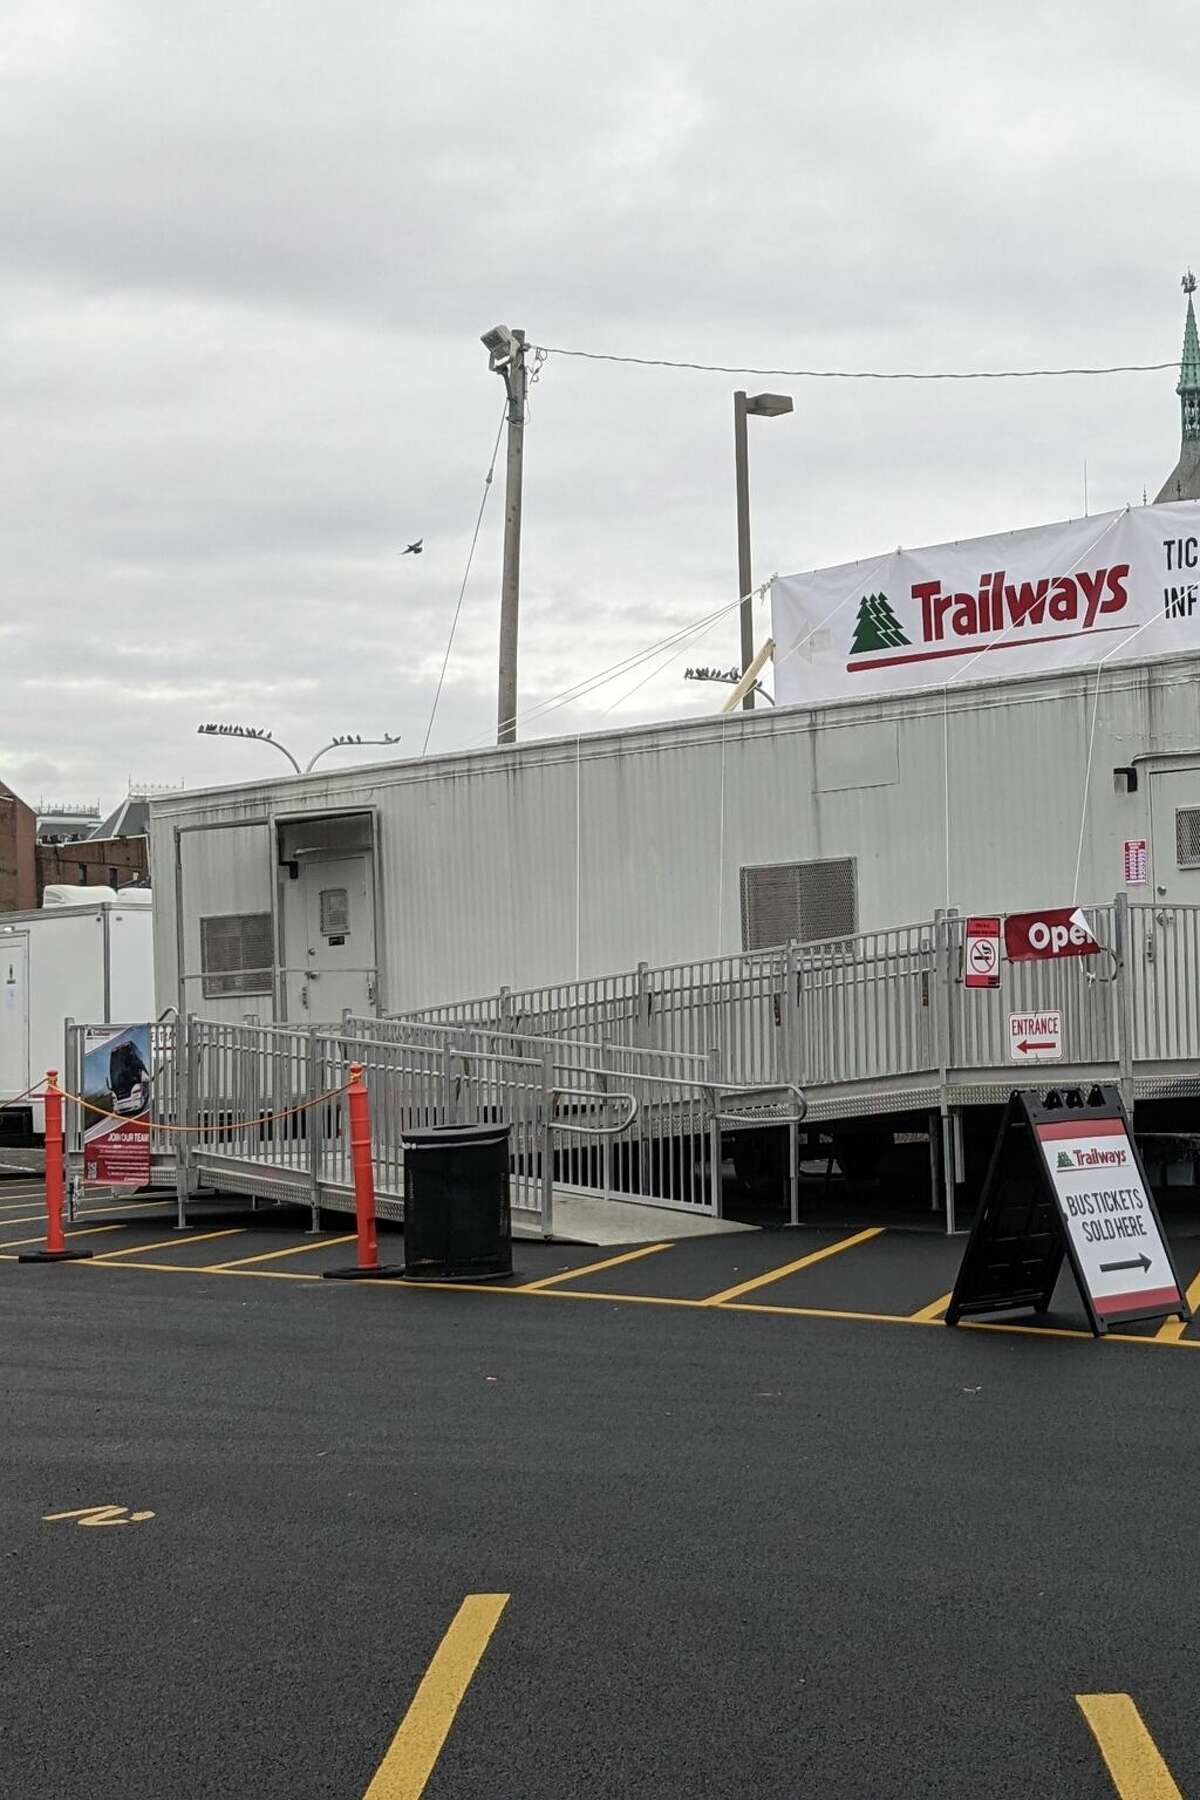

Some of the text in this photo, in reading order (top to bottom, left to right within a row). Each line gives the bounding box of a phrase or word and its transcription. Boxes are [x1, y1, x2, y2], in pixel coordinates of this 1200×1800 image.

[911, 564, 1130, 642] Trailways
[1011, 1016, 1059, 1036] ENTRANCE
[1073, 1148, 1127, 1166] Trailways
[1065, 1188, 1144, 1217] BUS TICKETS
[1081, 1215, 1148, 1242] SOLD HERE
